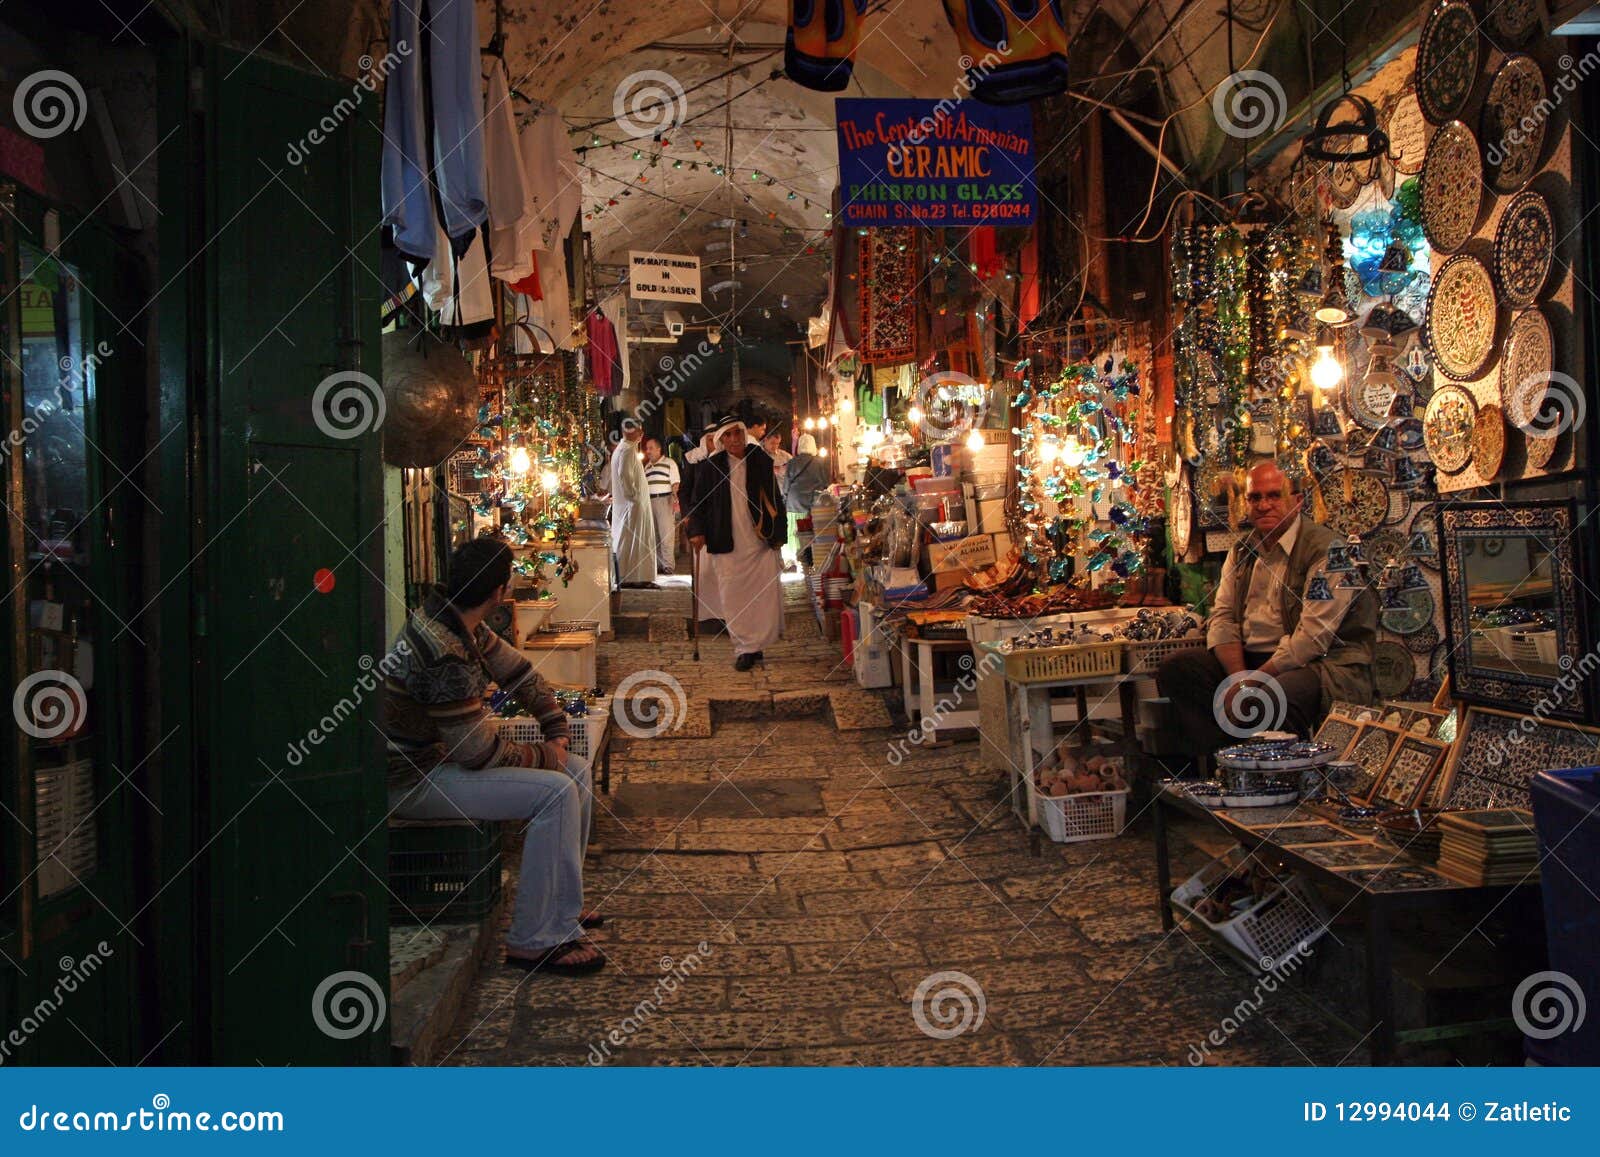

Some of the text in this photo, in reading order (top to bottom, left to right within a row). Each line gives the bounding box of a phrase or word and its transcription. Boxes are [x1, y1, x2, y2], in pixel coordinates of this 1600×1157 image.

[839, 119, 875, 151] The
[953, 111, 1029, 155] Armenian
[887, 145, 992, 178] CERAMIC
[957, 183, 1023, 201] GLASS
[847, 203, 887, 219] CHAIN
[647, 258, 668, 266] MAKE
[672, 260, 696, 269] NAMES
[662, 271, 670, 279] IN
[636, 283, 657, 292] GOLD
[670, 286, 697, 295] SILVER
